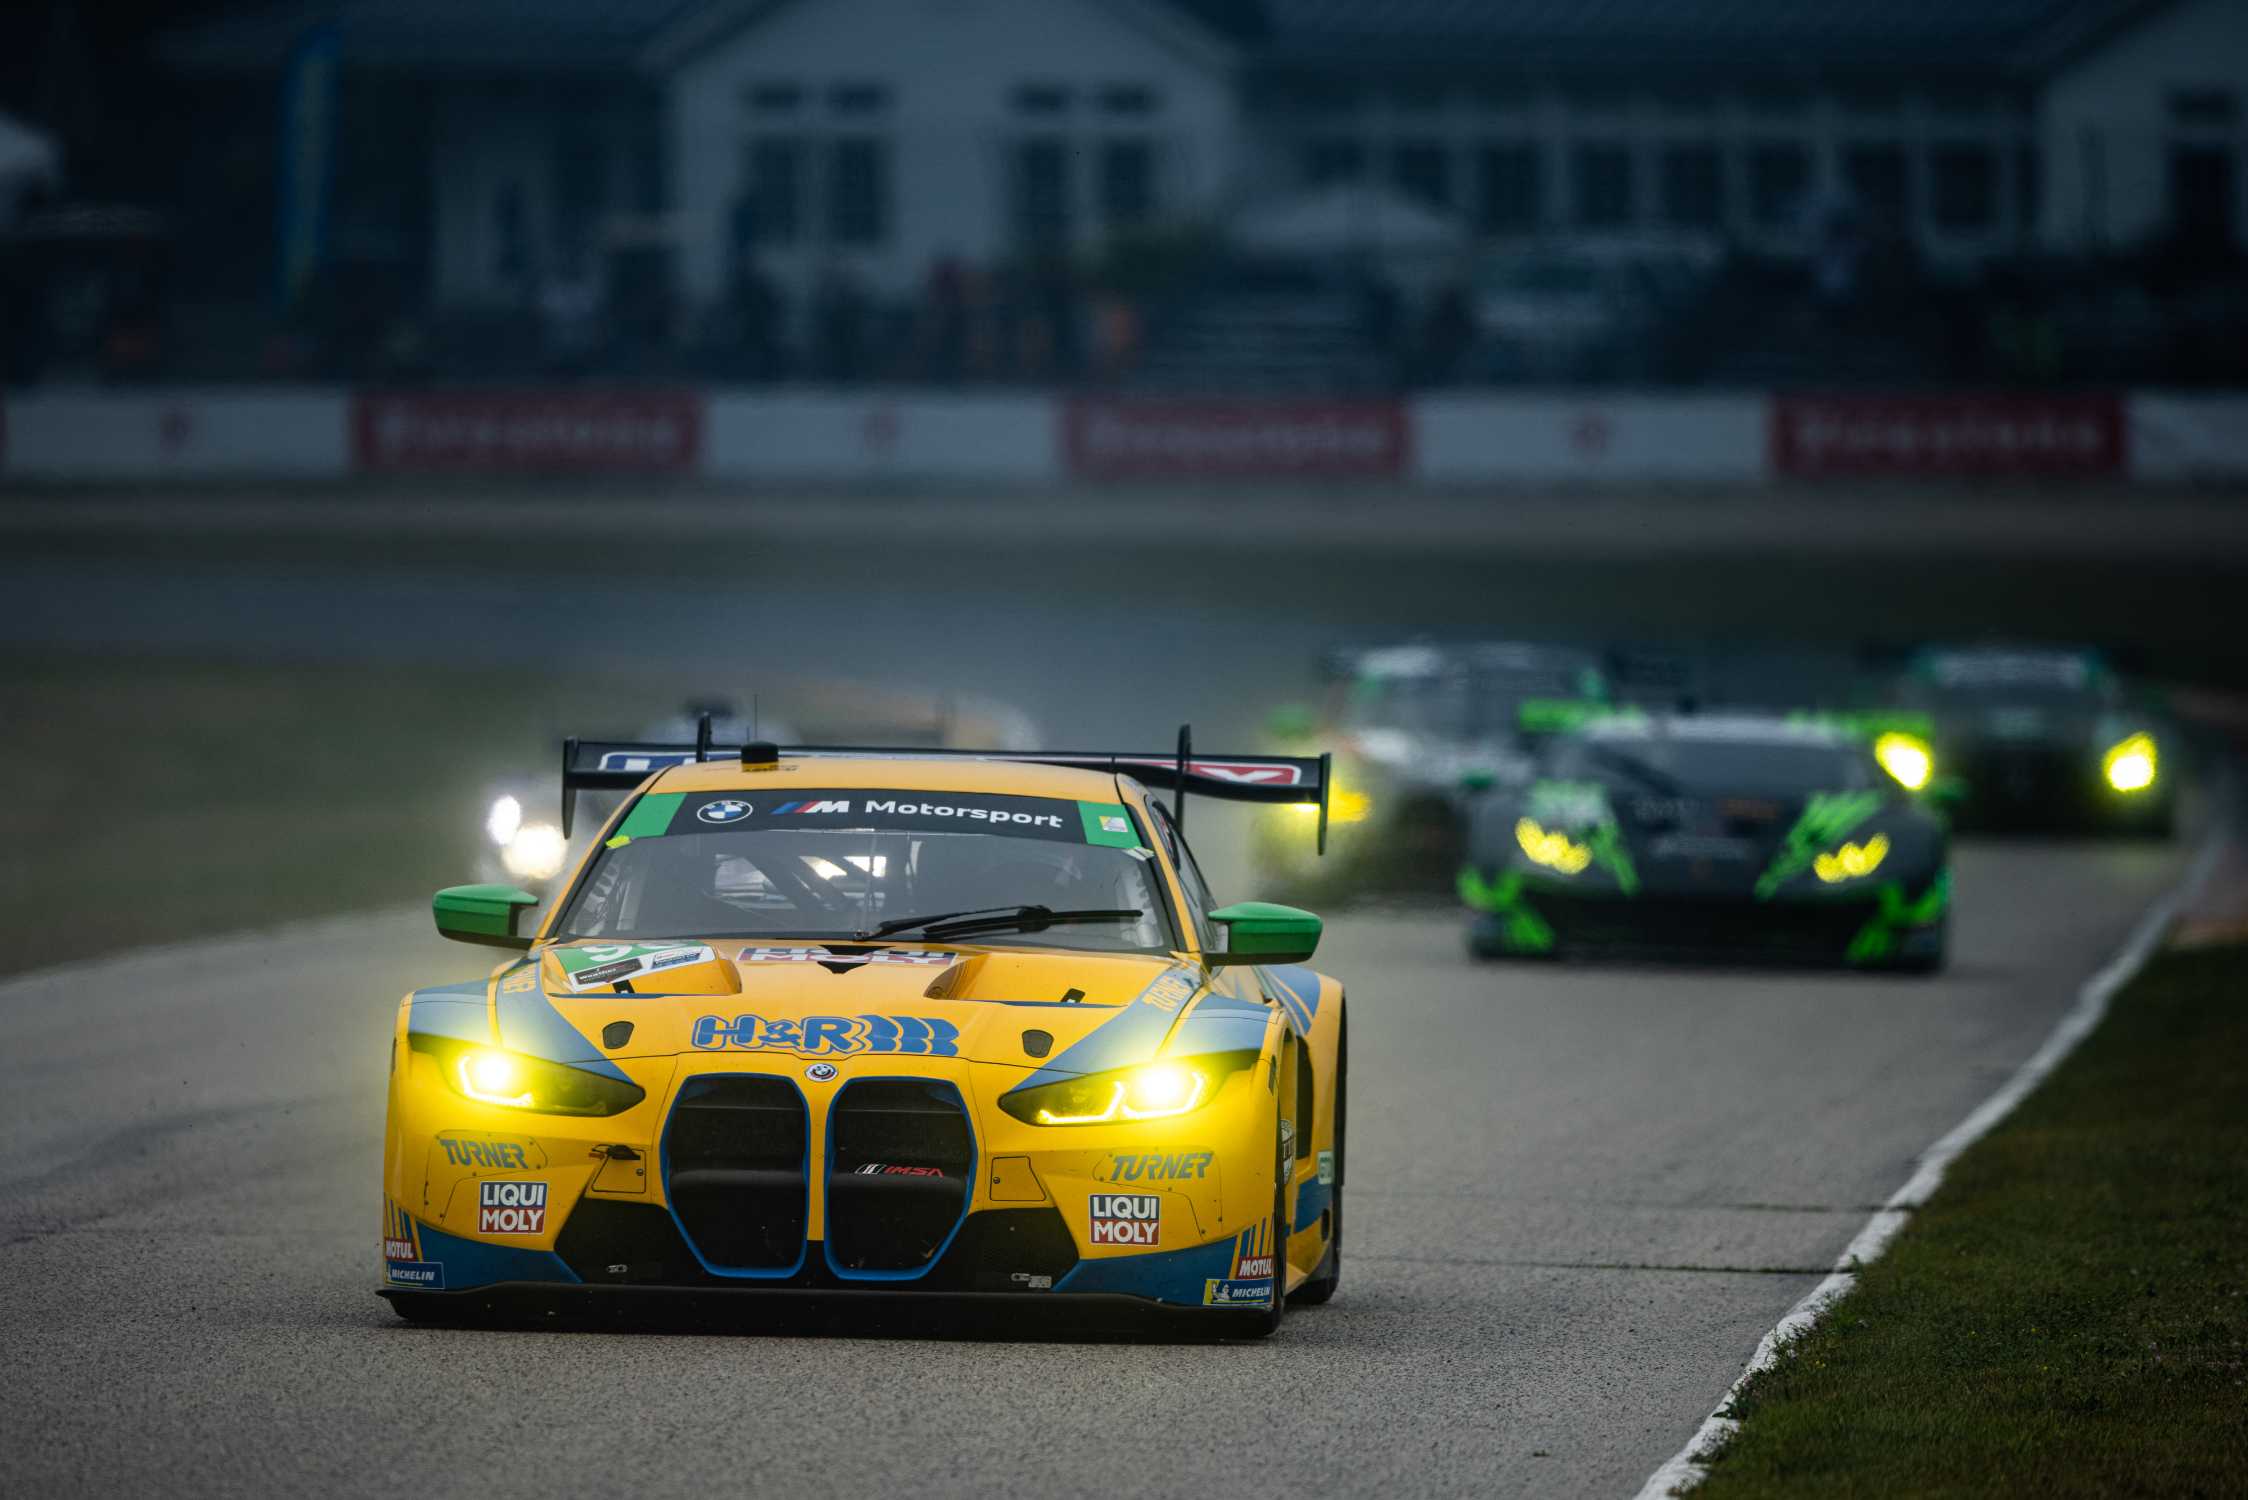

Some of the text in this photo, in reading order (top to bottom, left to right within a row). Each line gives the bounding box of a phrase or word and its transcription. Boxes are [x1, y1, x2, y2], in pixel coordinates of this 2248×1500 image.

[865, 800, 1063, 828] Motorsport
[691, 1014, 862, 1055] H&R
[440, 1138, 528, 1169] TURNER
[884, 1166, 944, 1178] IMSA
[1111, 1152, 1212, 1181] TURNER
[482, 1184, 545, 1206] LIQUI
[1093, 1196, 1157, 1219] LIQUI
[481, 1209, 544, 1231] MOLY
[1093, 1221, 1158, 1243] MOLY
[386, 1240, 413, 1258] MOTUL
[391, 1269, 435, 1280] MICHELIN
[1232, 1287, 1270, 1298] MICHELIN
